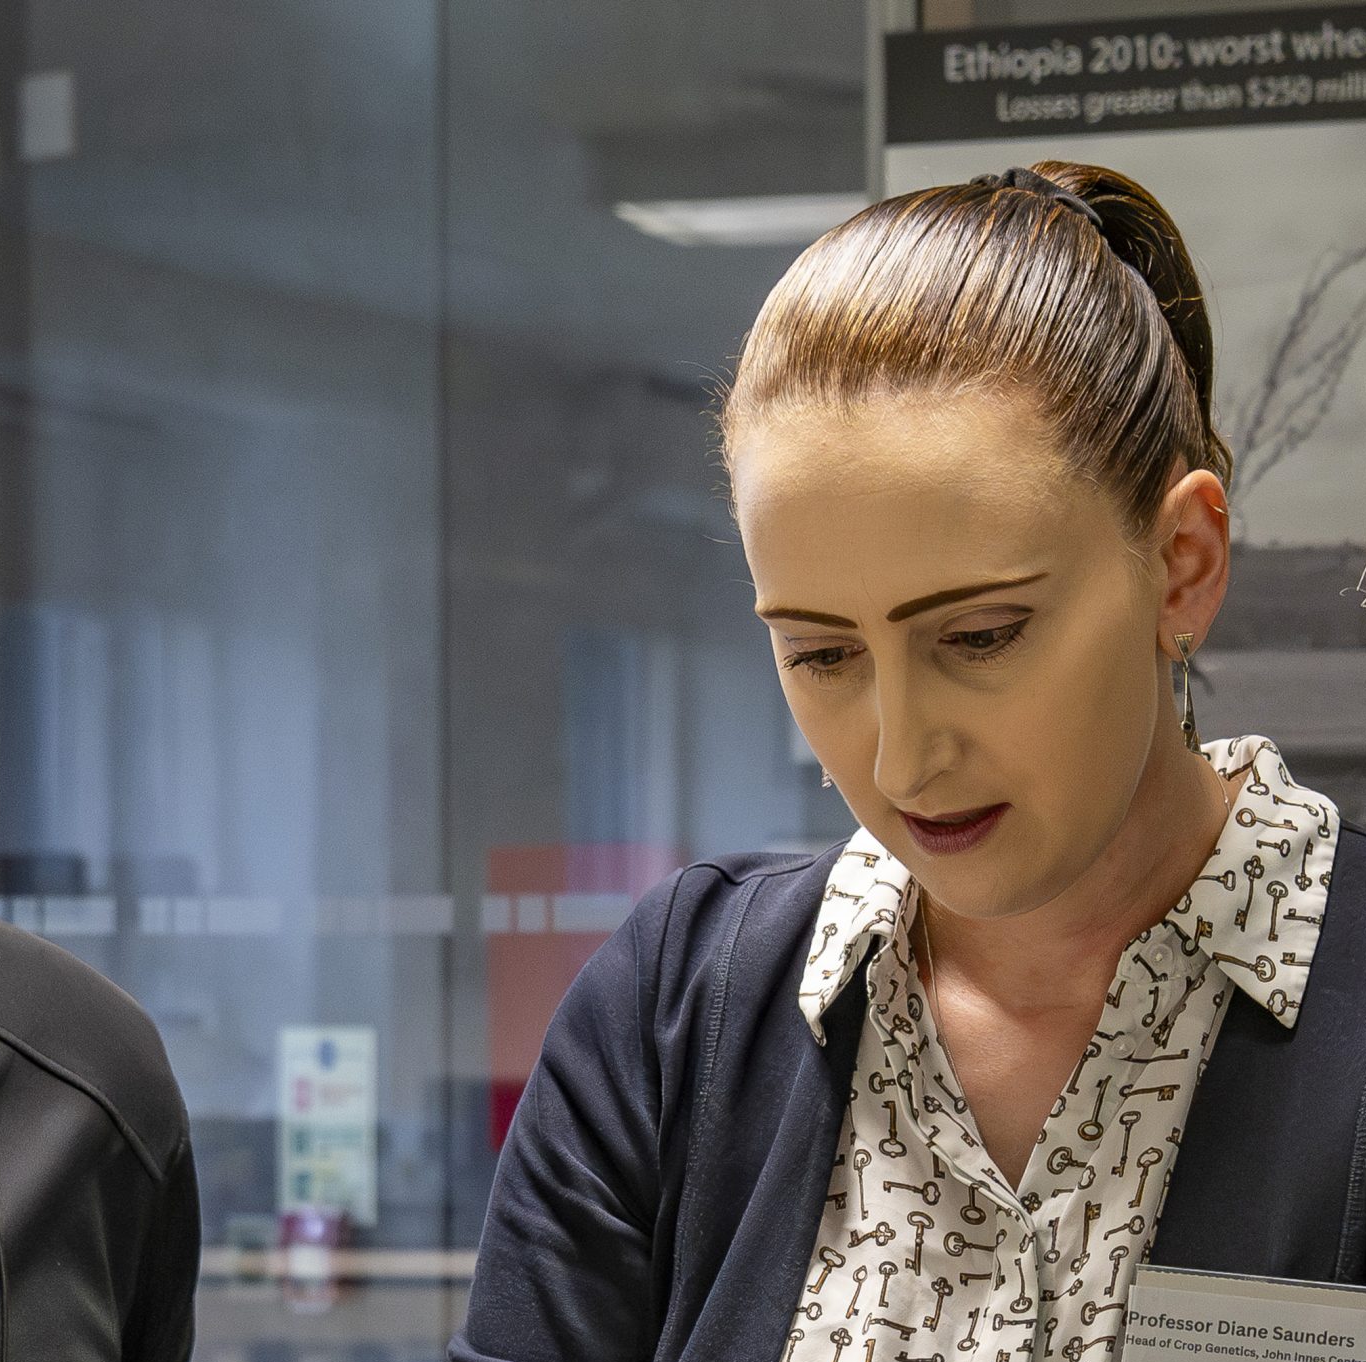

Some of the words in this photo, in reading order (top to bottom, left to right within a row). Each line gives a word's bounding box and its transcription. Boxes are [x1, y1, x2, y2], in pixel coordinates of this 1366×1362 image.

[943, 39, 1083, 84] Ethiopia
[1088, 32, 1184, 74] 2010:
[1187, 30, 1285, 67] worst
[995, 90, 1082, 122] Losses
[1083, 86, 1178, 123] greater
[1180, 78, 1244, 112] than
[1245, 74, 1313, 108] $250
[1125, 1334, 1156, 1348] Head
[1159, 1338, 1172, 1349] of
[1173, 1339, 1202, 1354] Crop
[1205, 1342, 1259, 1360] Genetics,
[1262, 1349, 1292, 1362] John
[1128, 1310, 1213, 1334] Professor
[1217, 1320, 1268, 1340] Diane
[1272, 1325, 1355, 1348] Saunders
